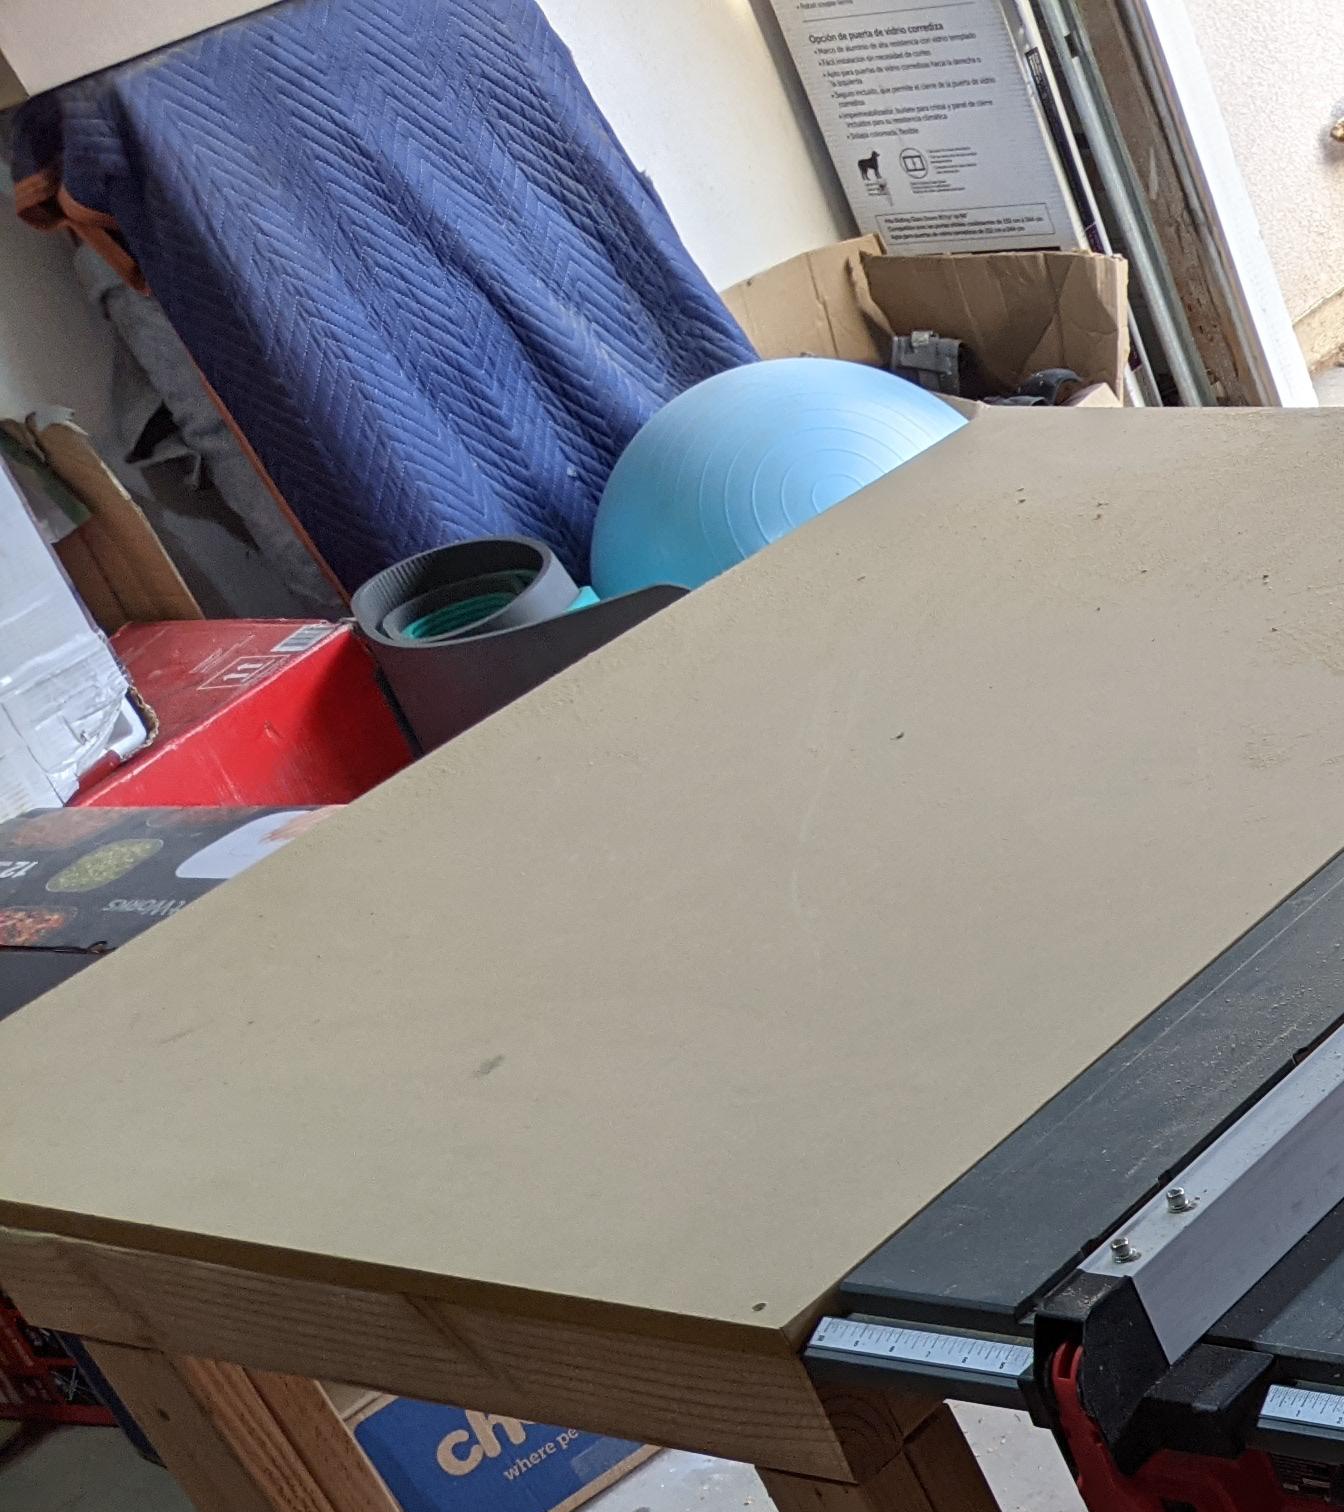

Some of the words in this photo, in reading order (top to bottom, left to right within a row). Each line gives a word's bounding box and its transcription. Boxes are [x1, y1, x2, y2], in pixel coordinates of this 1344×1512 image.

[809, 33, 837, 44] Opción
[838, 32, 848, 40] de
[849, 31, 873, 41] puerta
[874, 28, 884, 37] de
[885, 26, 906, 35] vidrio
[908, 22, 944, 33] corrediza
[436, 1409, 536, 1476] ch
[503, 1440, 557, 1481] where
